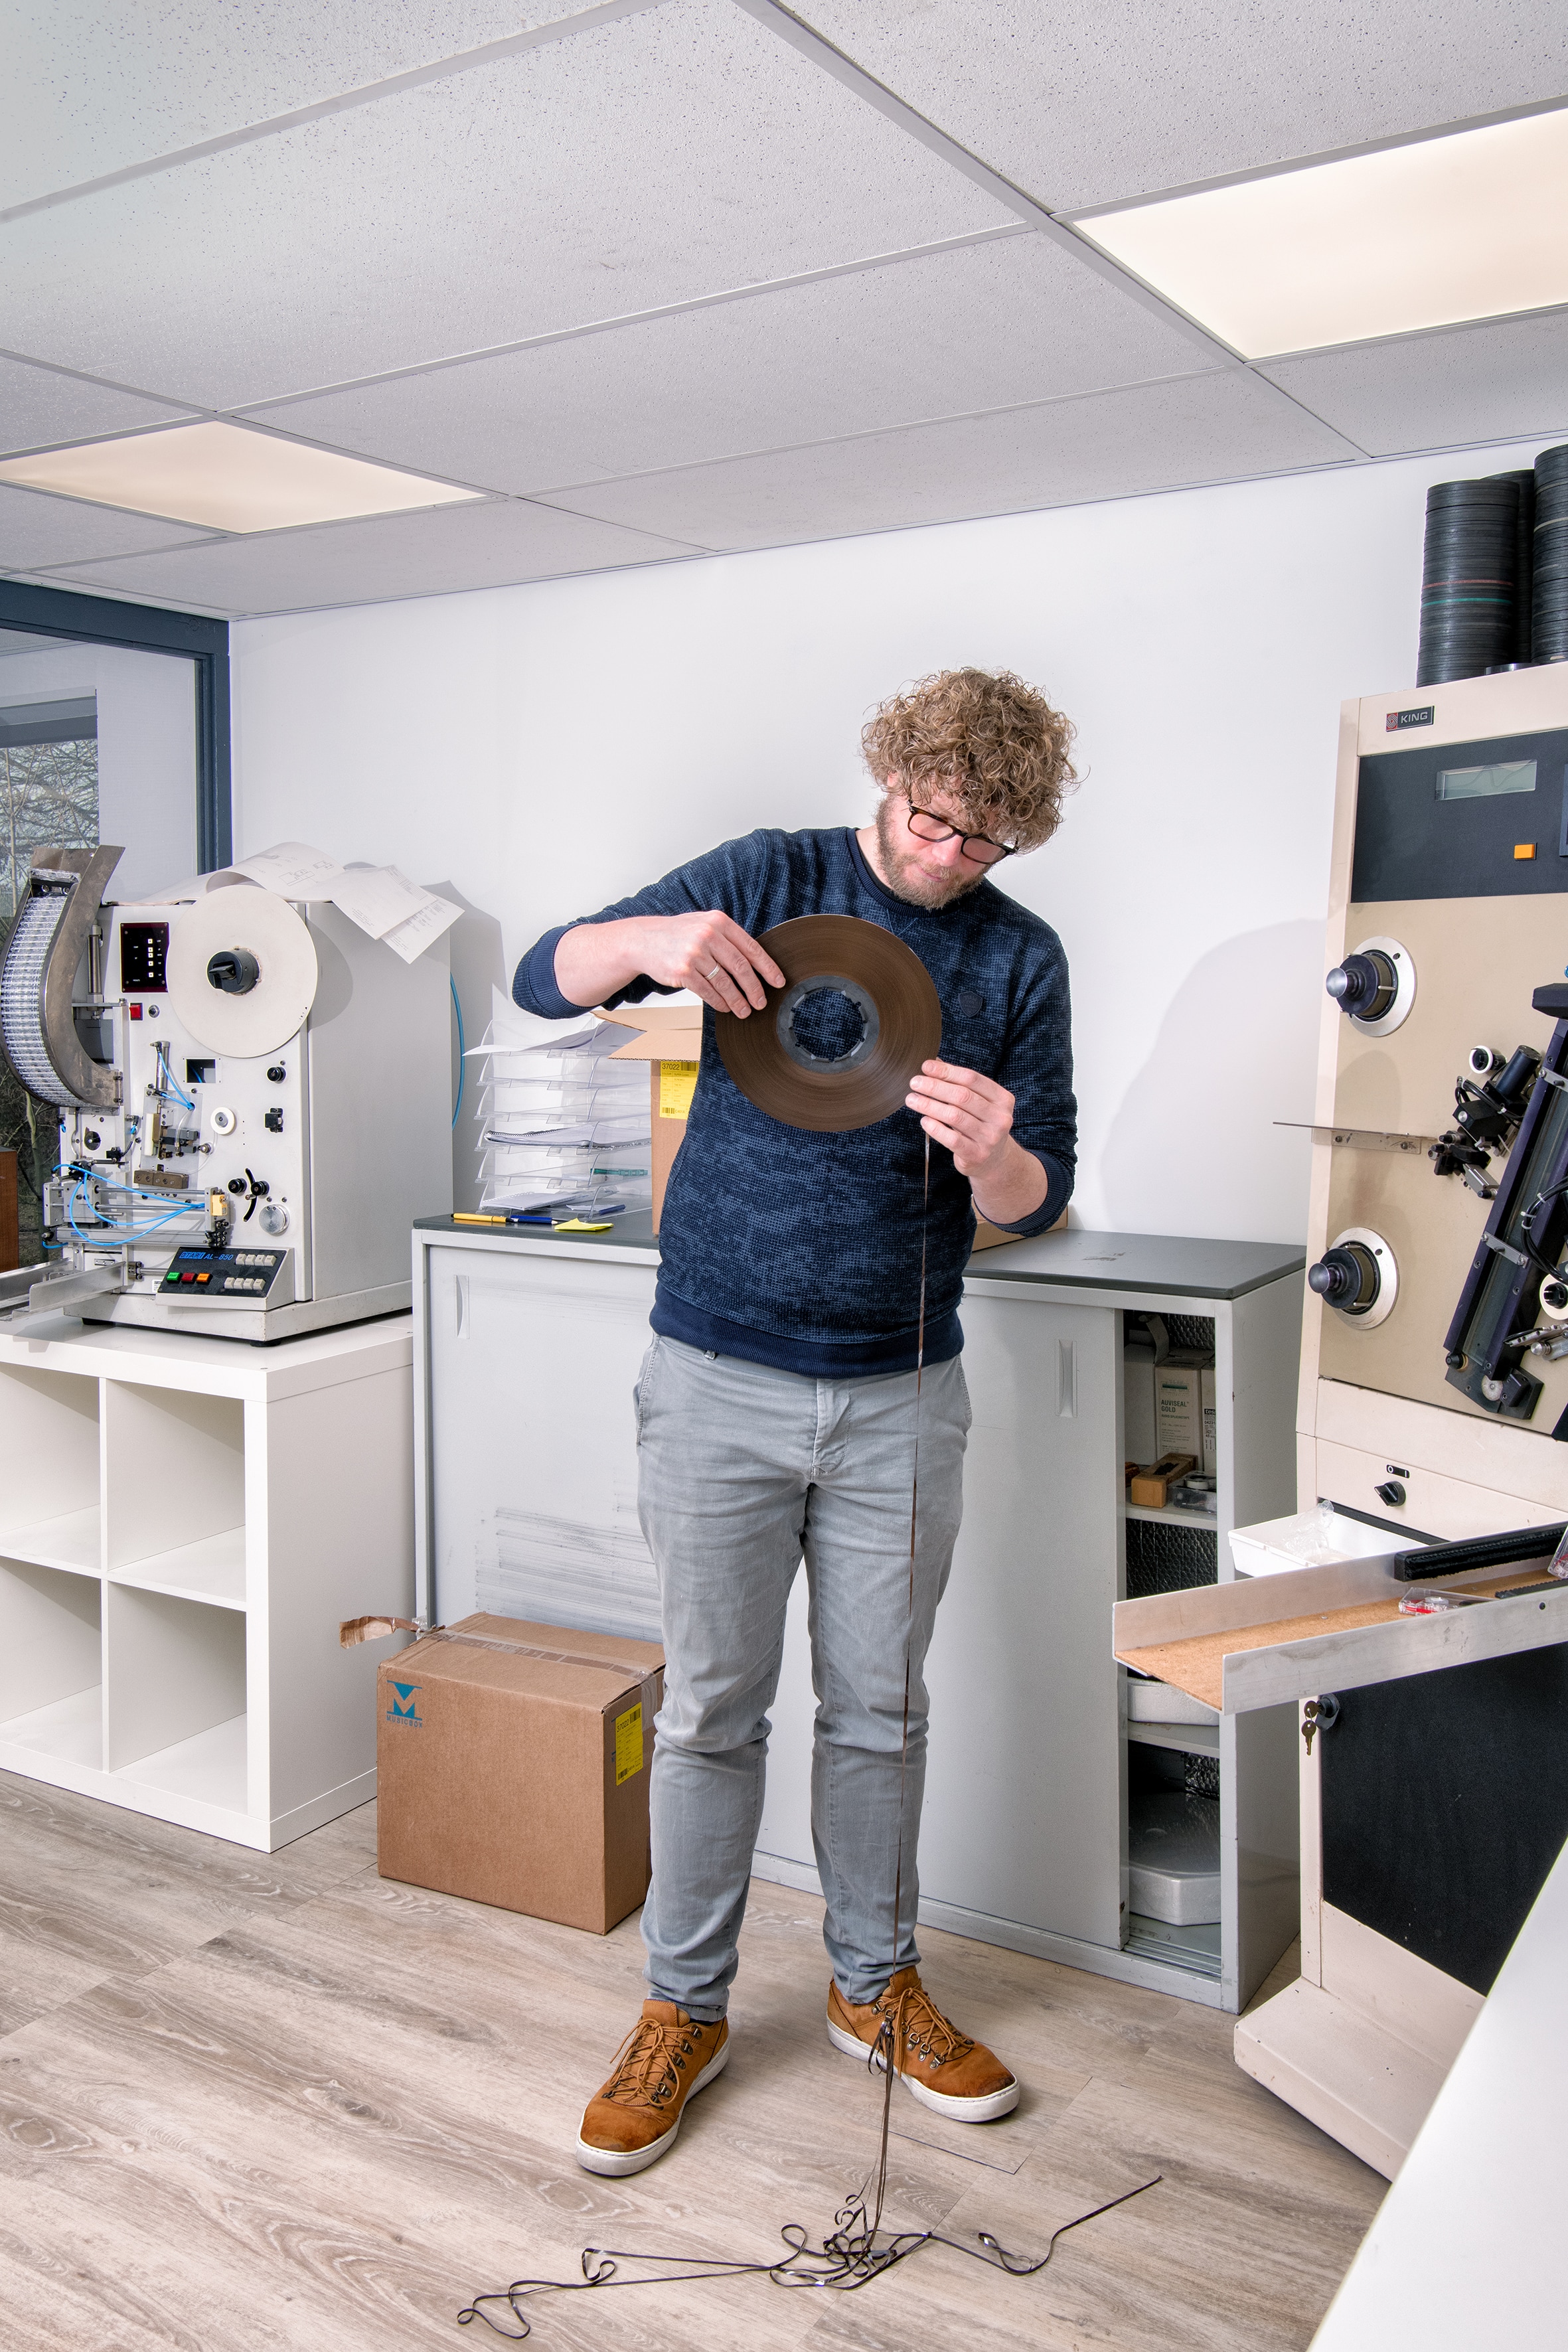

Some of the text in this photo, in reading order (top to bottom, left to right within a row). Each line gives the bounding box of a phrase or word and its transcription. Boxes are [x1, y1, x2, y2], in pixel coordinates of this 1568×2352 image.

[1401, 712, 1428, 724] KING
[386, 1715, 422, 1729] MUSICBOX
[617, 1719, 629, 1732] 37022
